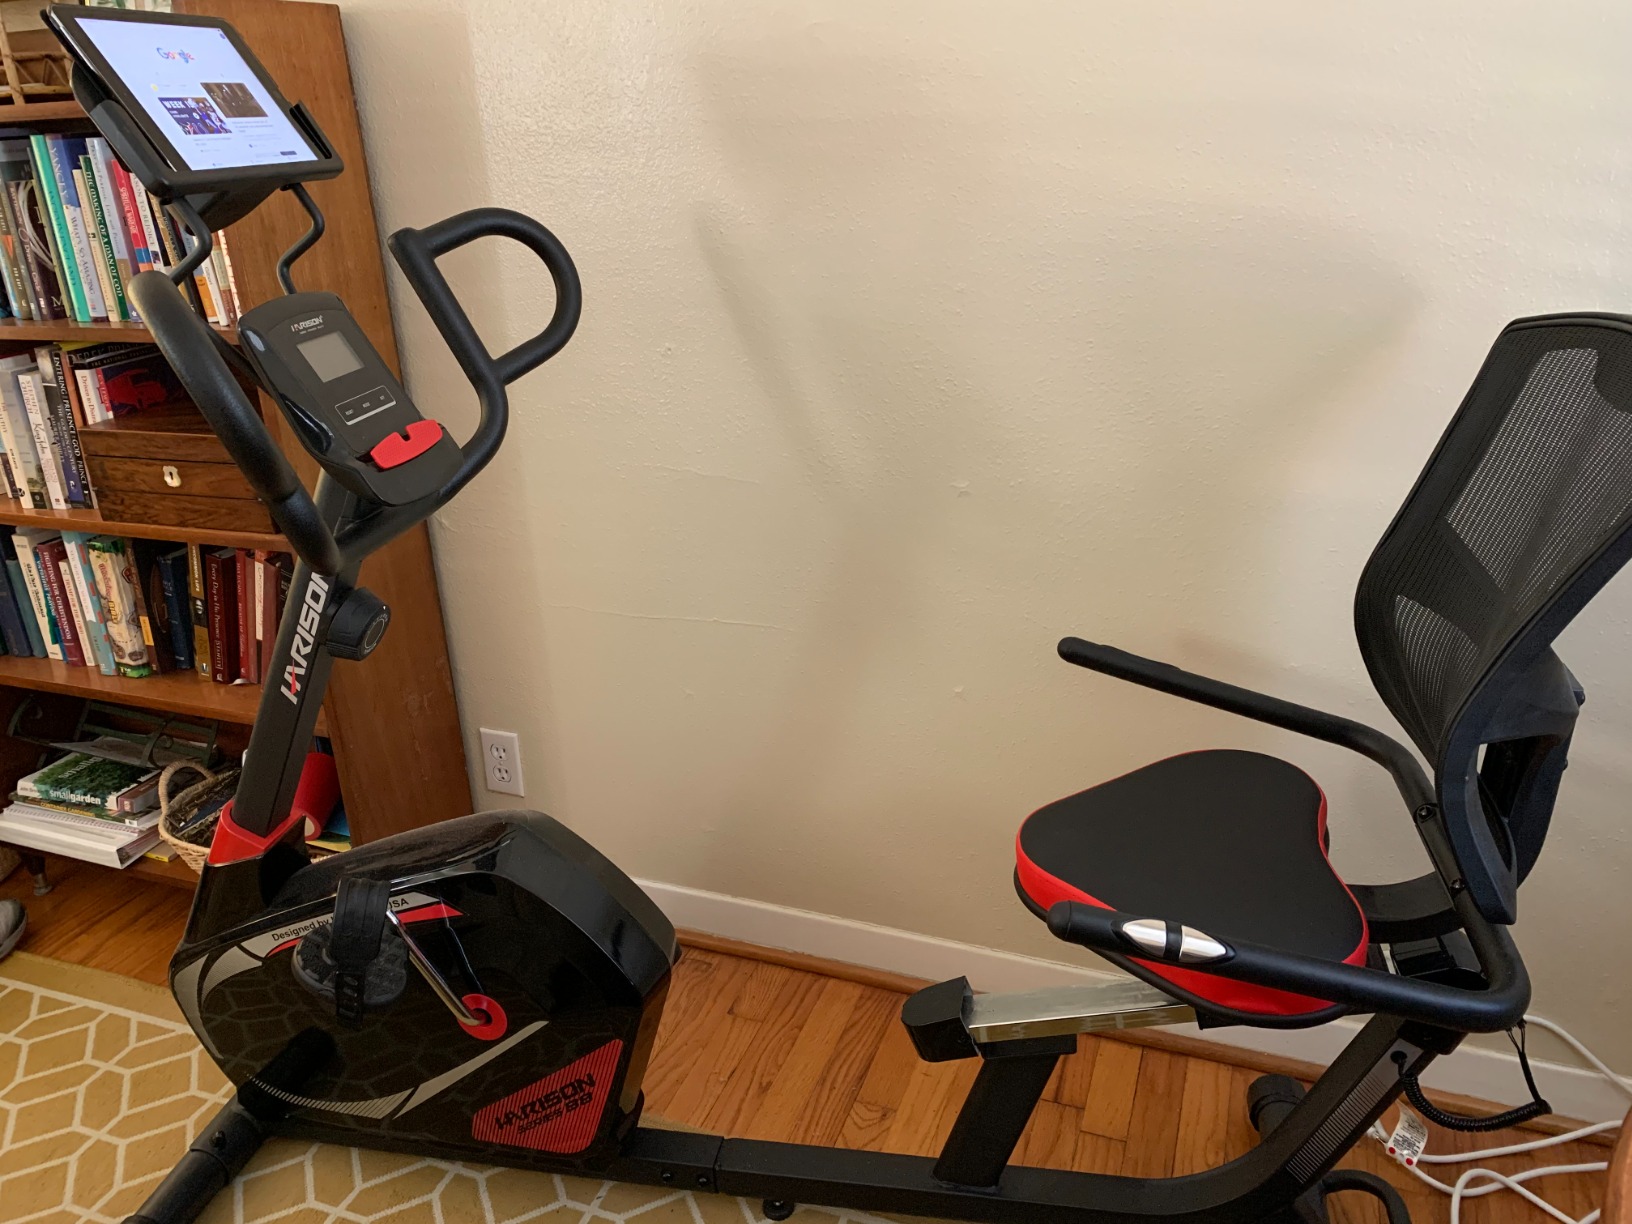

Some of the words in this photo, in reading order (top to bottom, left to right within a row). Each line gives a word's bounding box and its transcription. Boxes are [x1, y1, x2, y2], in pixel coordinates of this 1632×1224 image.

[157, 47, 195, 64] Google
[162, 101, 186, 110] WEEK
[51, 147, 69, 198] YANCEY
[132, 173, 143, 197] ASON
[119, 185, 132, 211] SPIRITUAL
[139, 201, 147, 212] TO
[86, 171, 94, 187] THE
[90, 188, 103, 222] MAKING
[100, 223, 107, 235] OF
[105, 244, 114, 264] MAN
[110, 265, 118, 277] OF
[142, 214, 155, 244] REJOICE
[24, 244, 32, 263] Draw
[31, 272, 41, 292] Circle
[83, 260, 95, 295] AMAZING
[21, 381, 33, 414] CHURCH
[25, 380, 39, 415] STEPHEN
[53, 356, 66, 395] ENTERING
[63, 399, 76, 434] PRESENCE
[73, 439, 81, 457] GOD
[80, 375, 91, 396] Driven
[88, 402, 98, 424] Distra
[33, 421, 45, 441] King
[37, 437, 47, 456] John
[66, 445, 77, 473] CENTURY
[77, 460, 87, 485] PRINCE
[43, 551, 55, 582] FIGHTING
[51, 582, 60, 595] FOR
[56, 595, 72, 639] CHRISTENDOM
[107, 599, 119, 624] BIBLE
[271, 924, 317, 942] Designed
[318, 918, 330, 930] by
